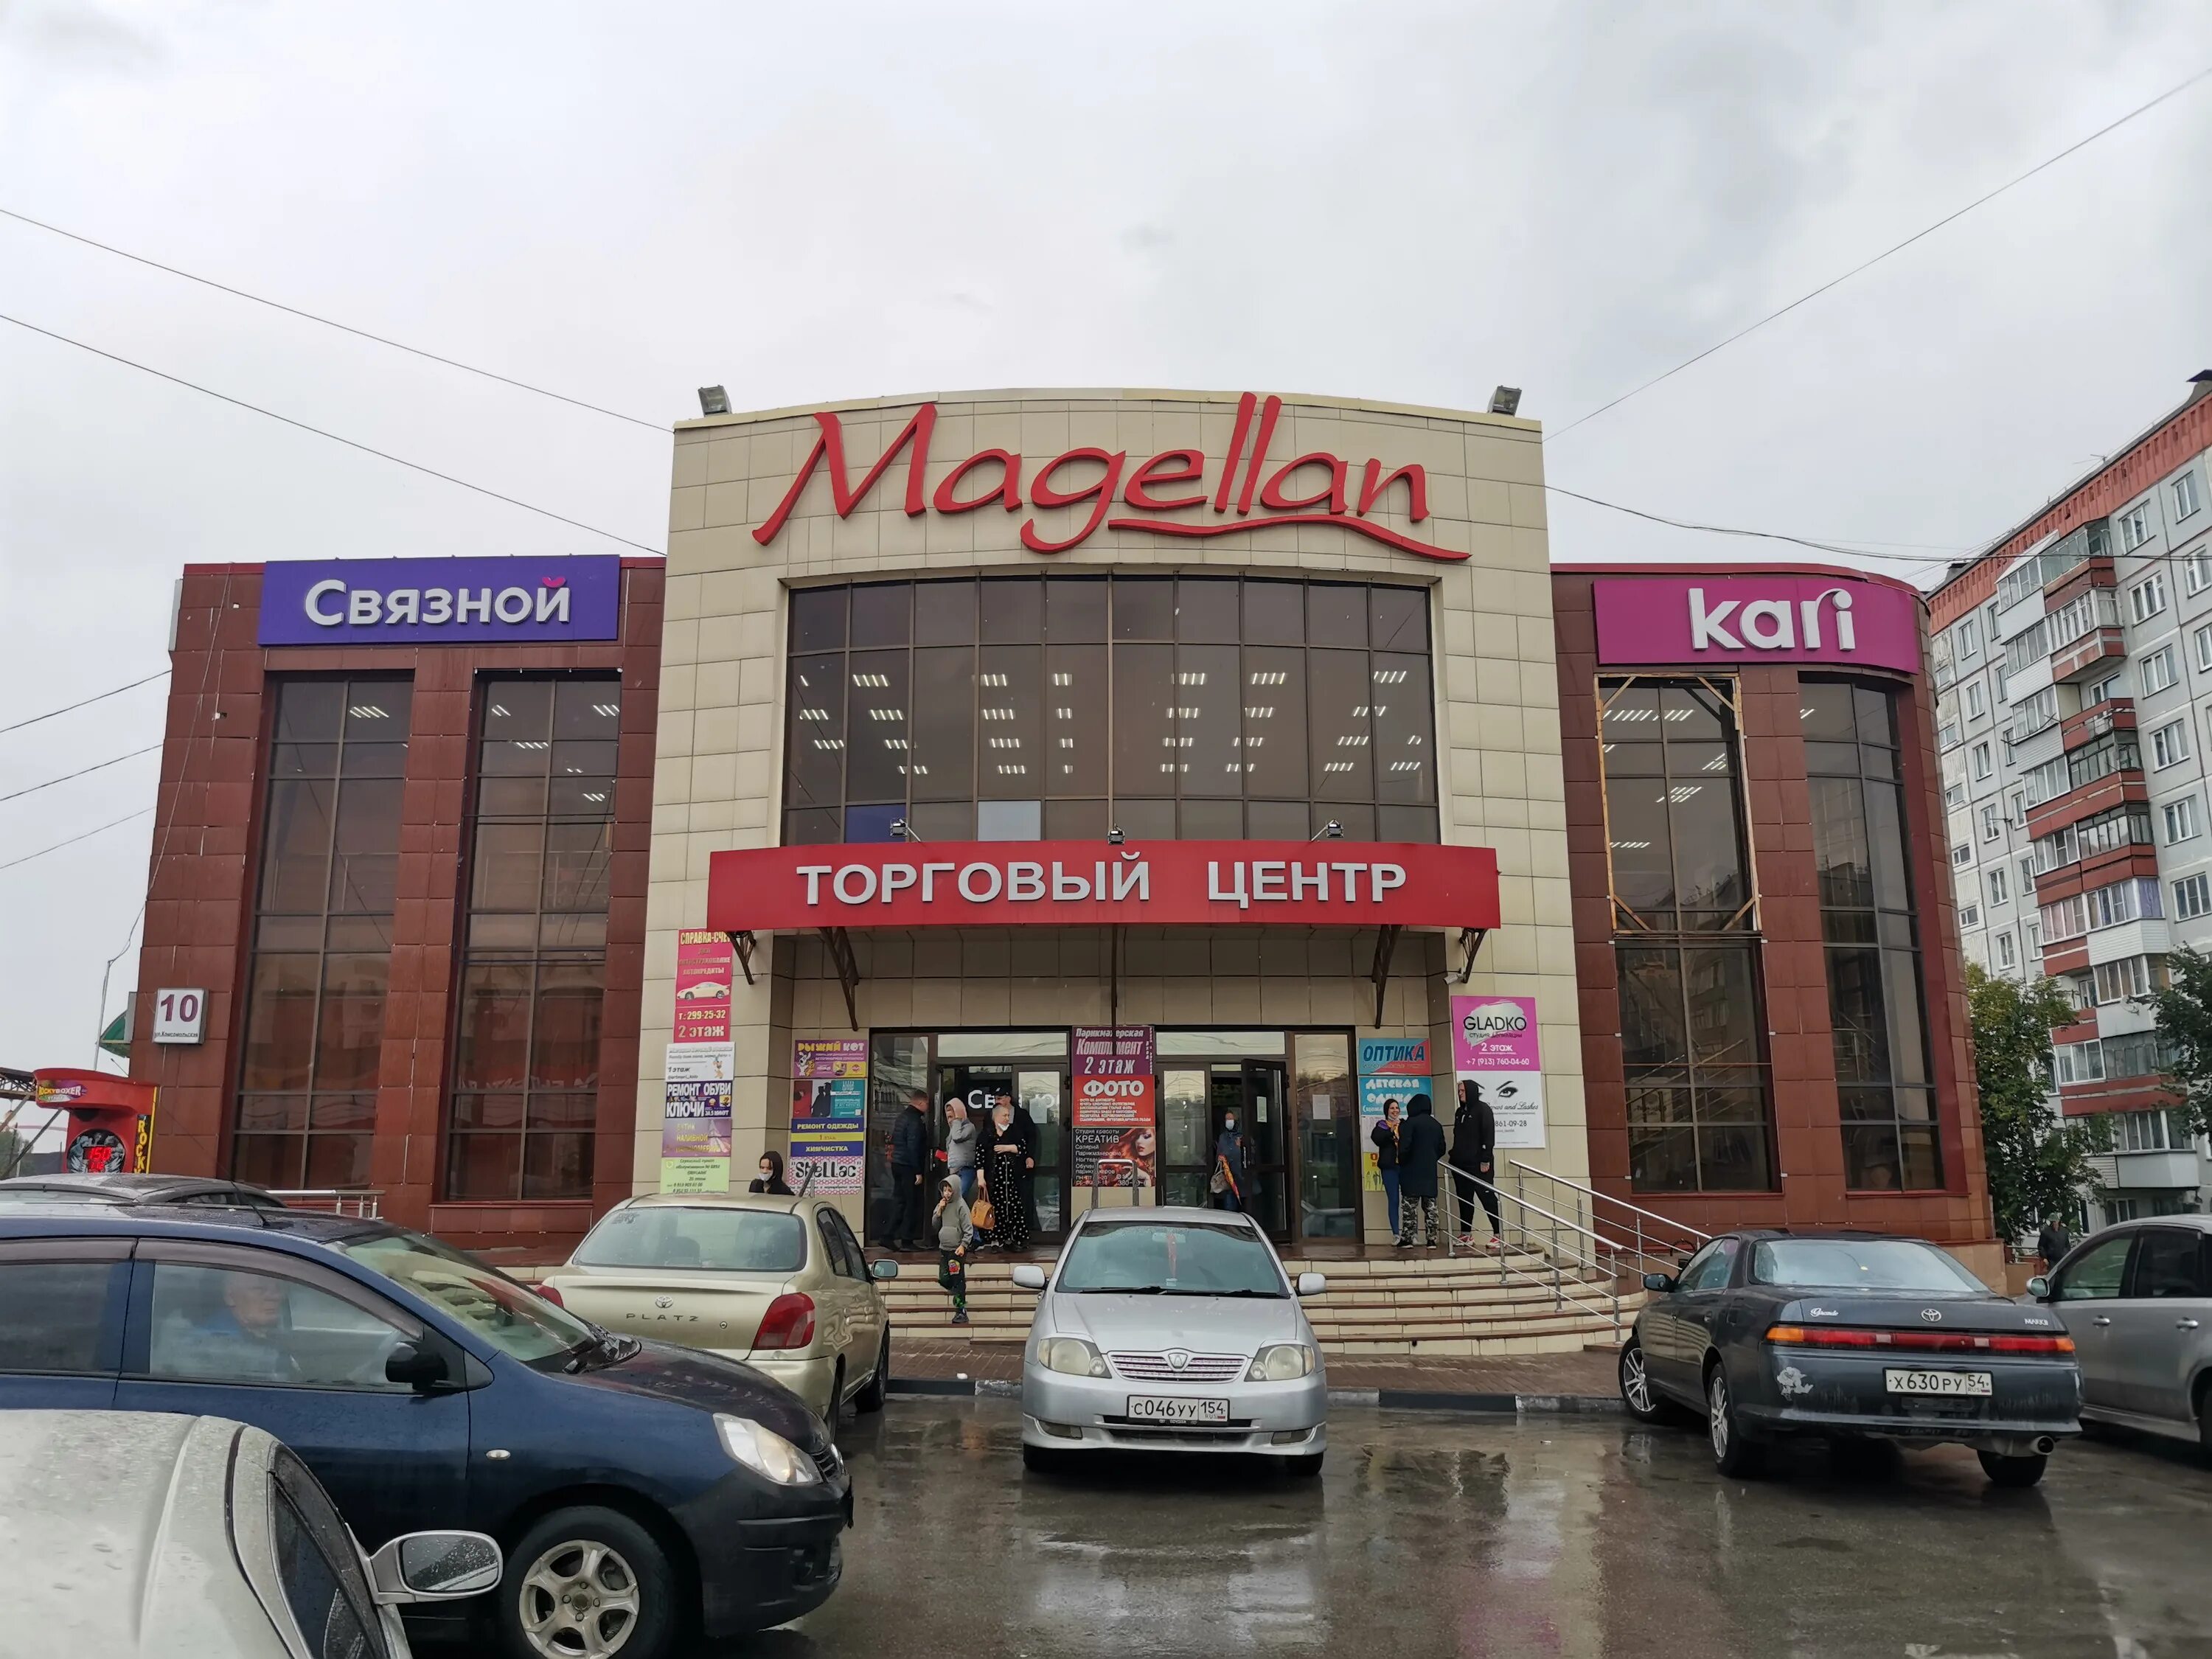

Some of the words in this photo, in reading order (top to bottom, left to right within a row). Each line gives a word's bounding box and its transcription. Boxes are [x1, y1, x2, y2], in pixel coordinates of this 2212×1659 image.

[752, 392, 1430, 556] Magellan
[305, 576, 571, 626] Связной
[1687, 587, 1857, 651] kari
[796, 852, 1150, 905] ТОРГОВЫЙ
[1208, 860, 1408, 909] ЦЕНТР
[160, 993, 198, 1023] 10
[1463, 1015, 1527, 1032] GLADKO
[678, 1025, 686, 1038] 2
[689, 1025, 724, 1038] этаж
[1076, 1027, 1144, 1039] Парикмаерская
[797, 1040, 841, 1052] РЫЖИЙ
[843, 1042, 865, 1051] КОТ
[1076, 1038, 1144, 1055] Комплмент
[1363, 1045, 1425, 1062] ОПТИКА
[1481, 1042, 1487, 1051] 2
[1489, 1044, 1513, 1052] этаж
[1084, 1056, 1094, 1074] 2
[1098, 1059, 1135, 1074] этаж
[667, 1083, 701, 1097] РЕМОНТ
[703, 1082, 731, 1096] ОБУВИ
[1082, 1079, 1144, 1097] ФОТО
[1366, 1079, 1420, 1090] ДЕТСКАЯ
[1366, 1093, 1413, 1105] ОДЕЖД
[1486, 1102, 1503, 1110] rows
[666, 1101, 705, 1118] КЛЮЧИ
[1076, 1135, 1120, 1144] КРЕАТИВ
[626, 1312, 699, 1322] PLATZ
[1967, 1374, 1985, 1388] 54
[1200, 1401, 1223, 1414] 154
